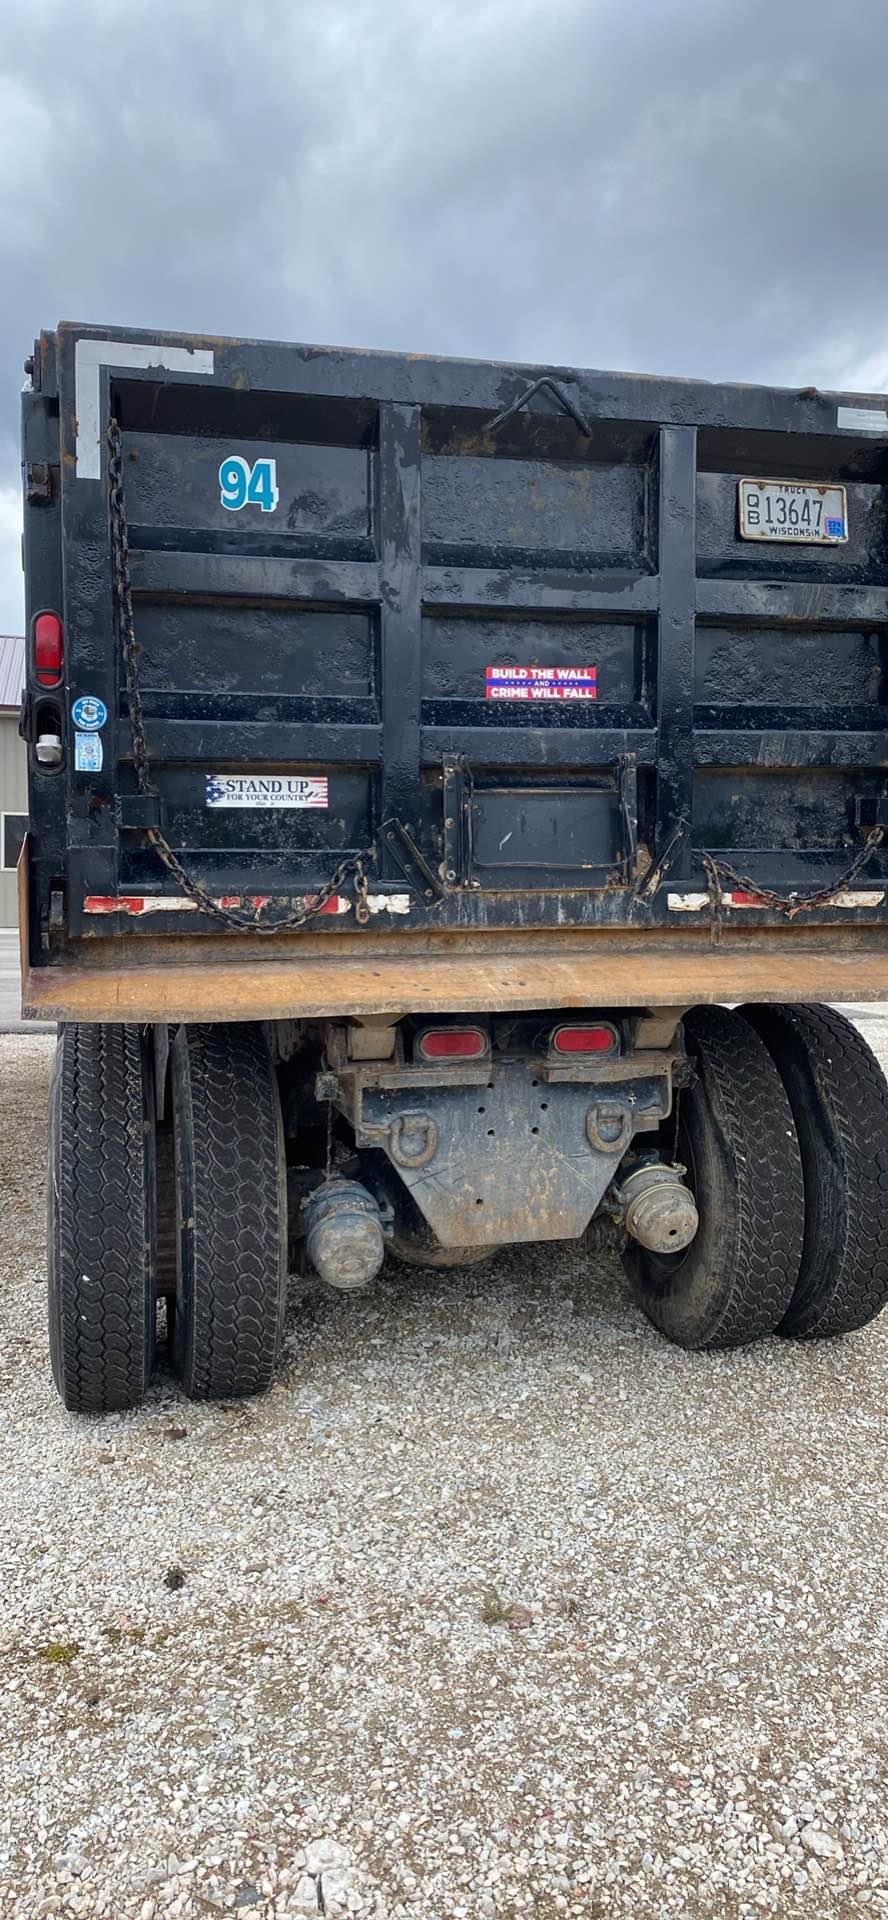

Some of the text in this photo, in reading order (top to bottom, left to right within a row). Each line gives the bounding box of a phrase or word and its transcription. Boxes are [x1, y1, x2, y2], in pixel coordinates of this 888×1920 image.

[218, 455, 279, 512] 94
[779, 487, 807, 495] TRUCK
[765, 496, 823, 526] 13647
[491, 667, 592, 680] BUILD THE WALL
[491, 687, 593, 699] CRIME WILL FALL
[225, 780, 309, 793] STAND UP
[226, 793, 307, 802] FOR YOUR COUNTRY
